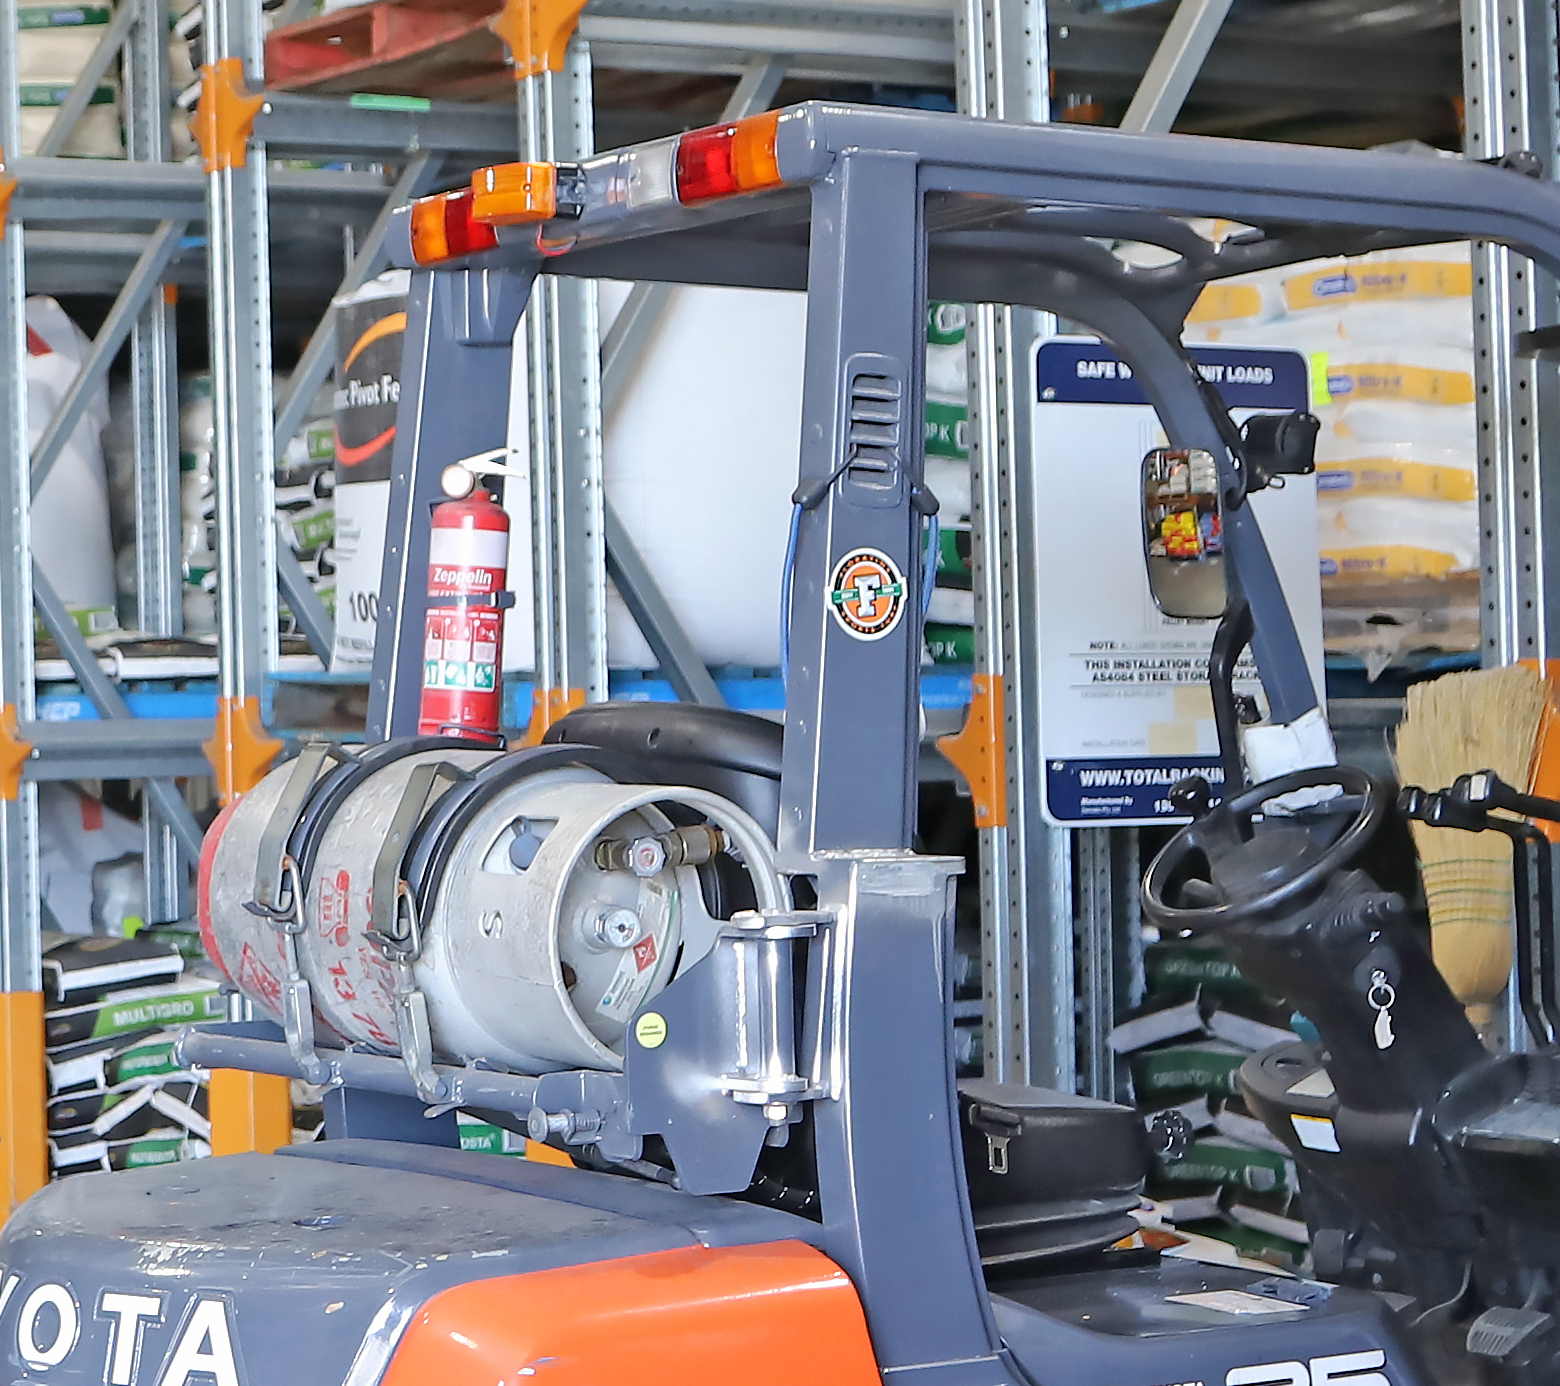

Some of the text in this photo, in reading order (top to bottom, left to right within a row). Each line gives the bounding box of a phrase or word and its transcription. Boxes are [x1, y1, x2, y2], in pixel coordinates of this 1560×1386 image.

[1076, 359, 1116, 380] SAFE
[1197, 365, 1225, 383] NIT
[1227, 366, 1274, 386] LOADS
[381, 375, 400, 403] Fe
[434, 567, 493, 587] Zeppolin
[349, 591, 379, 622] 100
[1085, 659, 1110, 669] THIS
[1114, 659, 1192, 669] INSTALLATION
[1138, 671, 1173, 682] STEEL
[479, 909, 504, 940] S
[113, 1000, 195, 1027] MULTIGRO
